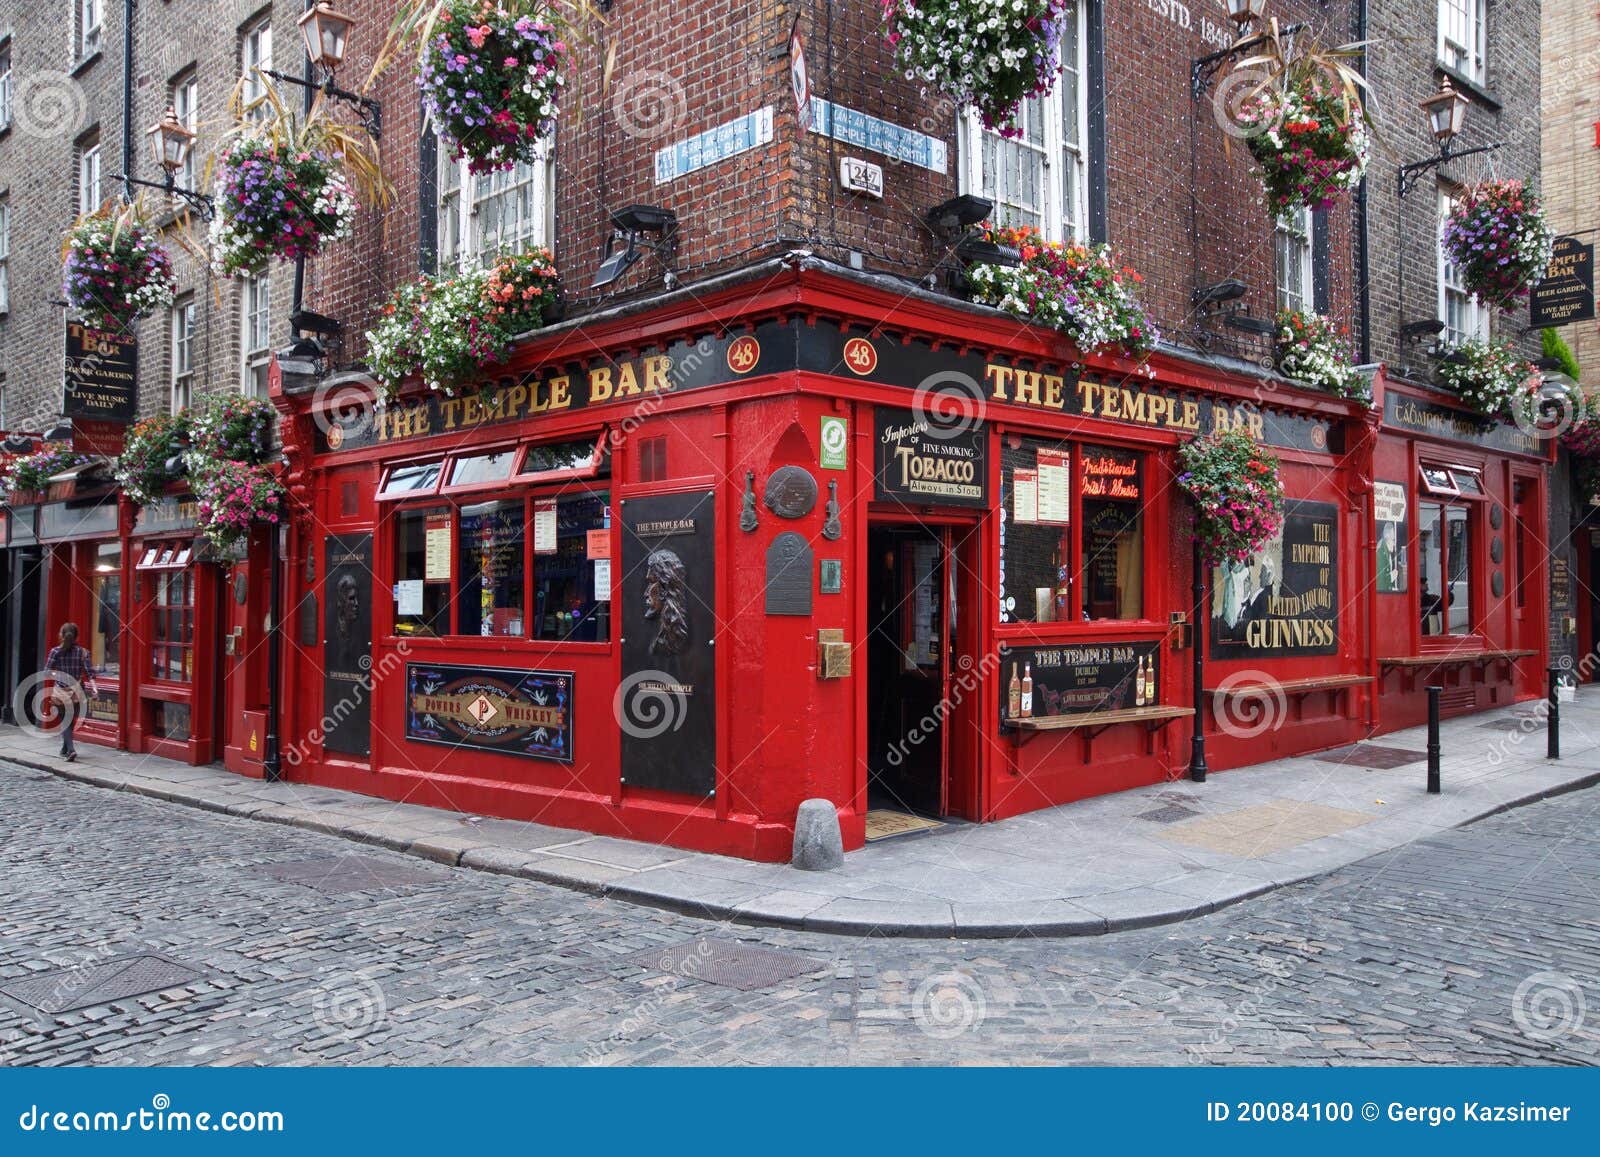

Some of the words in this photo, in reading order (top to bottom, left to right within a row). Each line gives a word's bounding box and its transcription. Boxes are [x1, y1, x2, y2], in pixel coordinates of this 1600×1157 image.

[833, 124, 866, 144] TEMPLE
[935, 149, 944, 164] 2
[1547, 252, 1587, 267] EMPLE
[1537, 288, 1556, 298] BEER
[1557, 284, 1587, 295] GARDEN
[1541, 305, 1557, 315] LIVE
[1559, 302, 1582, 313] MUSIC
[1551, 310, 1573, 319] DAILY
[732, 343, 754, 367] 48
[849, 343, 871, 366] 48
[95, 369, 133, 380] GARDEN
[72, 390, 95, 400] LIVE
[97, 394, 128, 404] MUSIC
[86, 400, 115, 410] DAILY
[375, 404, 431, 441] THE
[440, 375, 572, 430] TEMPLE
[588, 354, 673, 402] BAR
[987, 363, 1065, 409] THE
[1078, 381, 1201, 430] TEMPLE
[1212, 404, 1265, 441] BAR
[881, 421, 929, 446] Importers
[911, 436, 920, 444] OF
[923, 443, 941, 455] FINE
[941, 445, 974, 458] SMOKING
[1081, 457, 1137, 476] Traditional
[912, 481, 942, 492] Always
[957, 486, 980, 496] Stock
[1081, 476, 1106, 495] Irish
[1109, 478, 1139, 498] Music
[180, 502, 200, 519] TE
[636, 522, 650, 532] THE
[651, 520, 678, 531] TEMPLE
[680, 519, 694, 529] BAR
[1313, 523, 1330, 542] THE
[1292, 543, 1330, 564] EMPEROR
[1319, 567, 1330, 586] OF
[1267, 594, 1301, 617] MALTED
[1301, 587, 1333, 613] LIQUORS
[1246, 619, 1334, 648] GUINNESS
[1034, 650, 1062, 668] THE
[1064, 648, 1111, 666] TEMPLE
[1112, 646, 1135, 664] BAR
[1075, 665, 1100, 677] DUBLIN
[425, 698, 461, 714] POWERS
[478, 699, 489, 722] P
[505, 705, 553, 723] WHISKEY
